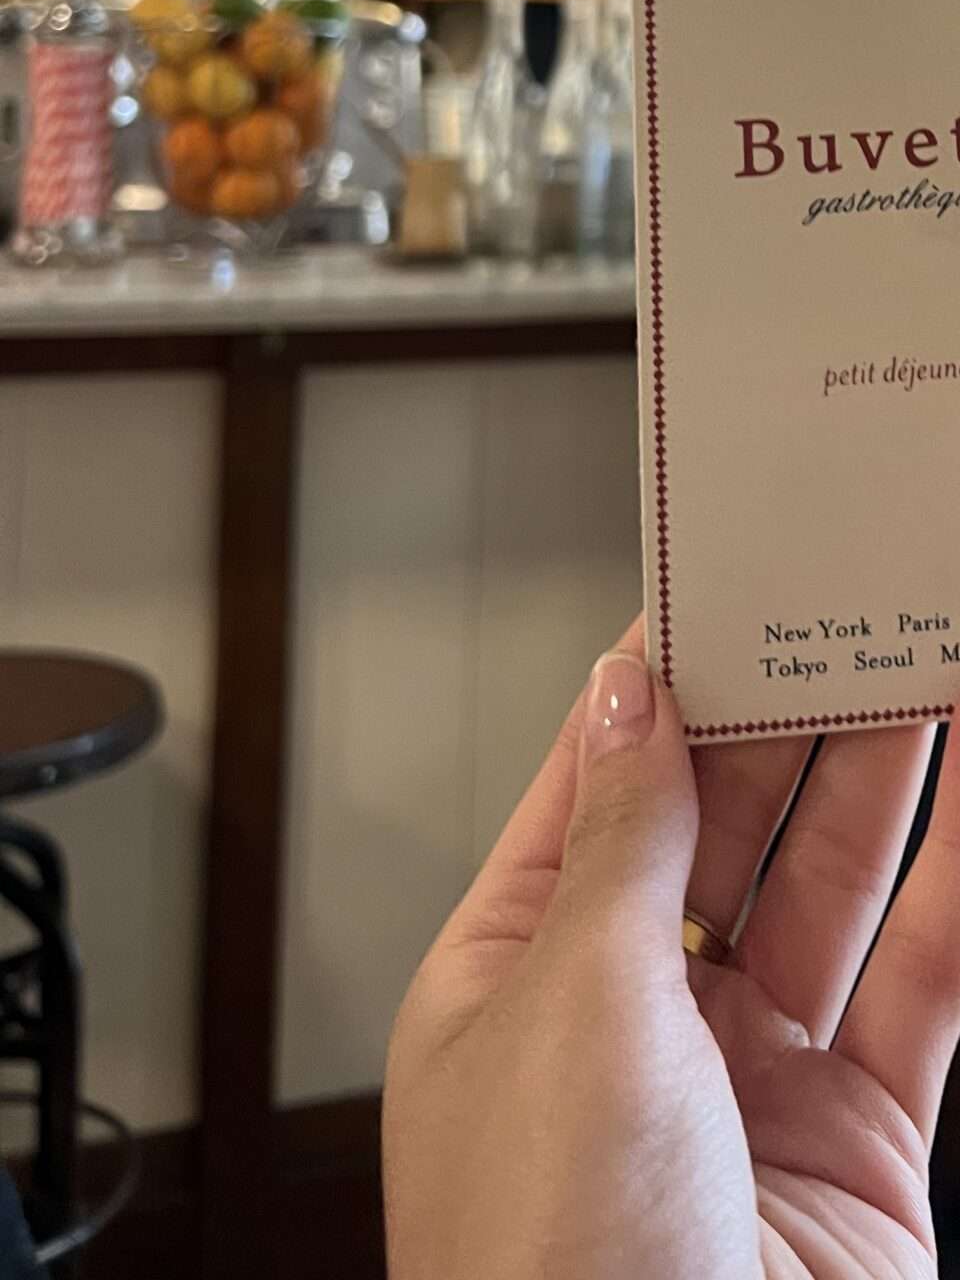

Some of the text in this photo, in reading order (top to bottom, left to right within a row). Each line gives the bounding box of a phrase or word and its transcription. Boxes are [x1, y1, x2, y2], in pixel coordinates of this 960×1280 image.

[823, 360, 876, 398] petit
[764, 622, 812, 645] New
[816, 615, 873, 640] York
[897, 612, 951, 635] Paris
[758, 656, 829, 683] Tokyo
[853, 646, 915, 672] Seoul
